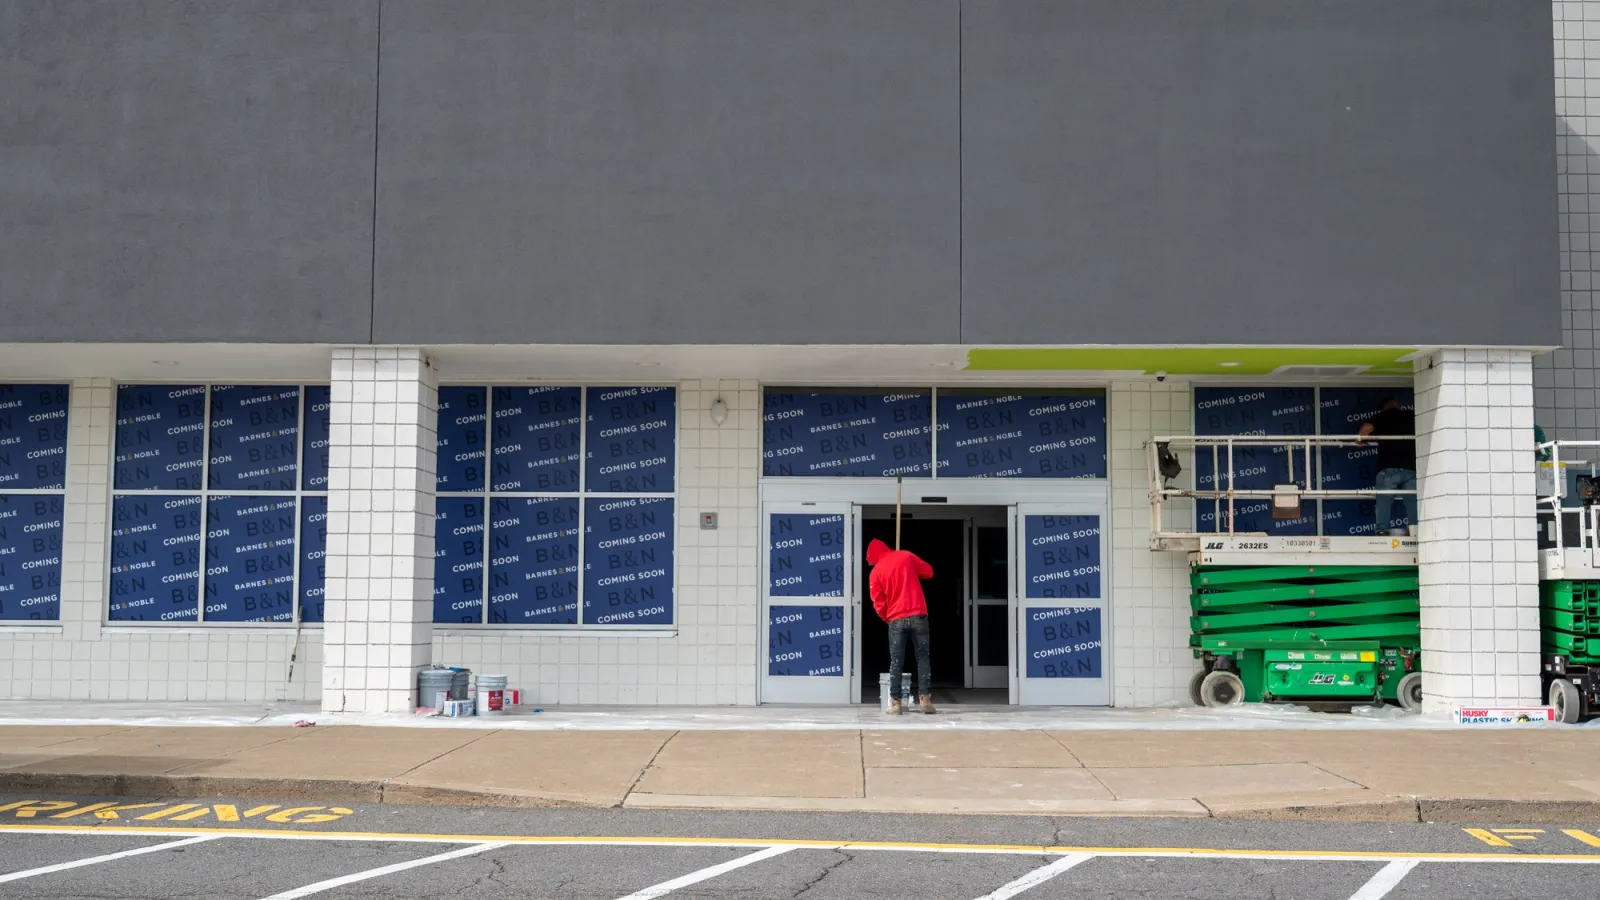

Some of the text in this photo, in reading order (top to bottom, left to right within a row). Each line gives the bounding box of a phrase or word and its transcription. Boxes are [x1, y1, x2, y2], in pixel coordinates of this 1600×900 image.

[169, 385, 205, 399] COMING
[601, 388, 637, 400] COMING
[240, 396, 271, 405] BARNES
[956, 400, 988, 410] BARNES
[1198, 392, 1265, 409] COMING SOON
[496, 408, 521, 417] SOON
[1029, 400, 1095, 416] COMING SOON
[1273, 406, 1304, 416] BARNES
[29, 410, 65, 422] COMING
[136, 413, 161, 422] NOBLE
[777, 409, 803, 419] SOON
[168, 421, 204, 435] COMING
[529, 421, 560, 431] BARNES
[600, 420, 666, 437] COMING SOON
[810, 423, 842, 433] BARNES
[850, 417, 876, 426] NOBLE
[240, 432, 271, 442] BARNES
[883, 428, 920, 439] COMING
[956, 437, 987, 446] BARNES
[996, 431, 1022, 440] NOBLE
[495, 444, 521, 454] SOON
[1029, 436, 1096, 453] COMING SOON
[27, 447, 63, 458] COMING
[134, 450, 159, 458] NOBLE
[777, 446, 803, 456] SOON
[166, 459, 203, 473] COMING
[528, 458, 559, 468] BARNES
[600, 457, 666, 474] COMING SOON
[810, 460, 841, 470] BARNES
[850, 454, 875, 463] NOBLE
[238, 469, 269, 479] BARNES
[996, 468, 1022, 477] NOBLE
[1200, 467, 1266, 484] COING SOON
[494, 481, 521, 492] SOON
[165, 496, 201, 509] COMING
[600, 499, 636, 511] COMING
[237, 506, 268, 515] BARNES
[1201, 504, 1268, 521] COING SOON
[493, 518, 519, 528] SOON
[810, 515, 841, 525] BARNES
[1275, 517, 1307, 527] BARNES
[24, 521, 60, 532] COMING
[131, 524, 156, 533] NOBLE
[164, 533, 200, 546] COMING
[526, 532, 558, 542] BARNES
[599, 532, 665, 548] COMING SOON
[1033, 527, 1100, 545] COMING SOON
[236, 543, 267, 553] BARNES
[776, 539, 802, 548] SOON
[493, 555, 519, 565] SOON
[810, 553, 841, 563] BARNES
[22, 558, 58, 569] COMING
[130, 561, 155, 570] NOBLE
[162, 570, 199, 583] COMING
[526, 569, 557, 579] BARNES
[598, 569, 664, 586] COMING SOON
[1033, 565, 1100, 583] COMING SOON
[235, 580, 266, 590] BARNES
[776, 576, 802, 586] SOON
[21, 595, 57, 606] COMING
[129, 598, 154, 607] NOBLE
[492, 593, 518, 603] SOON
[160, 608, 198, 621] COMING
[525, 607, 556, 617] BARNES
[597, 606, 664, 624] COMING SOON
[1033, 608, 1071, 620] COMING
[776, 614, 802, 624] SOON
[809, 628, 841, 638] BARNES
[1034, 640, 1101, 658] COMING SOON
[776, 652, 802, 662] SOON
[808, 666, 841, 676] BARNES
